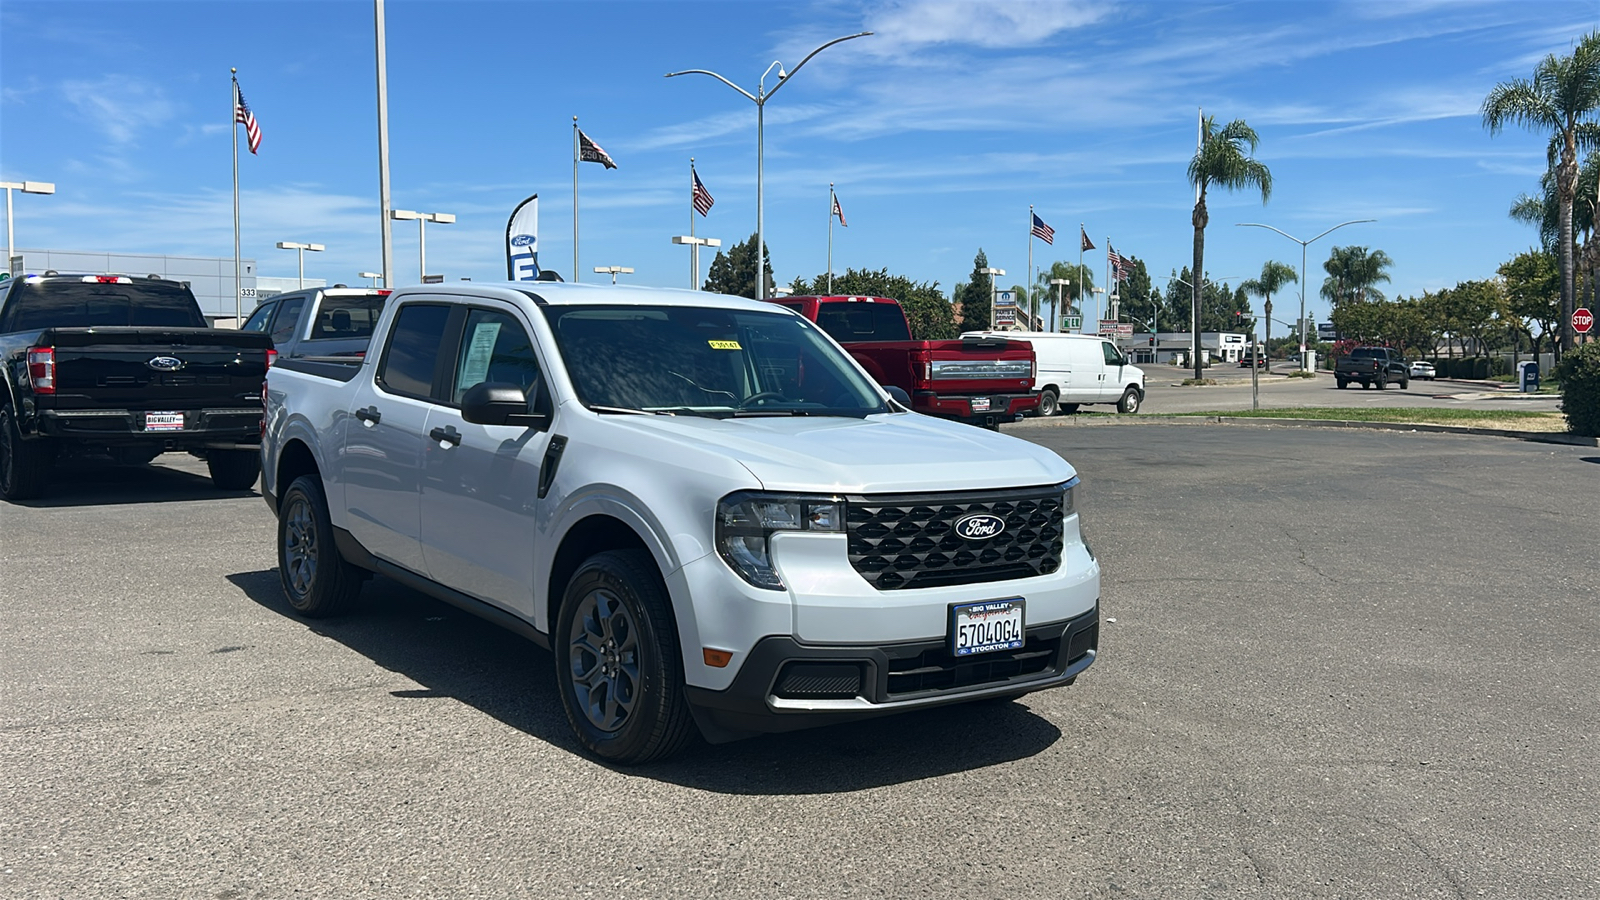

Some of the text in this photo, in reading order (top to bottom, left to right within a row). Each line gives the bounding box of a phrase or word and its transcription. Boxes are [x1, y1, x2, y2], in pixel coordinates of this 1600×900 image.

[582, 150, 598, 160] 250
[514, 236, 531, 246] Ford
[241, 288, 256, 297] 333
[1573, 315, 1592, 325] STOP
[965, 518, 997, 536] Ford
[971, 642, 1009, 653] STOCKTON
